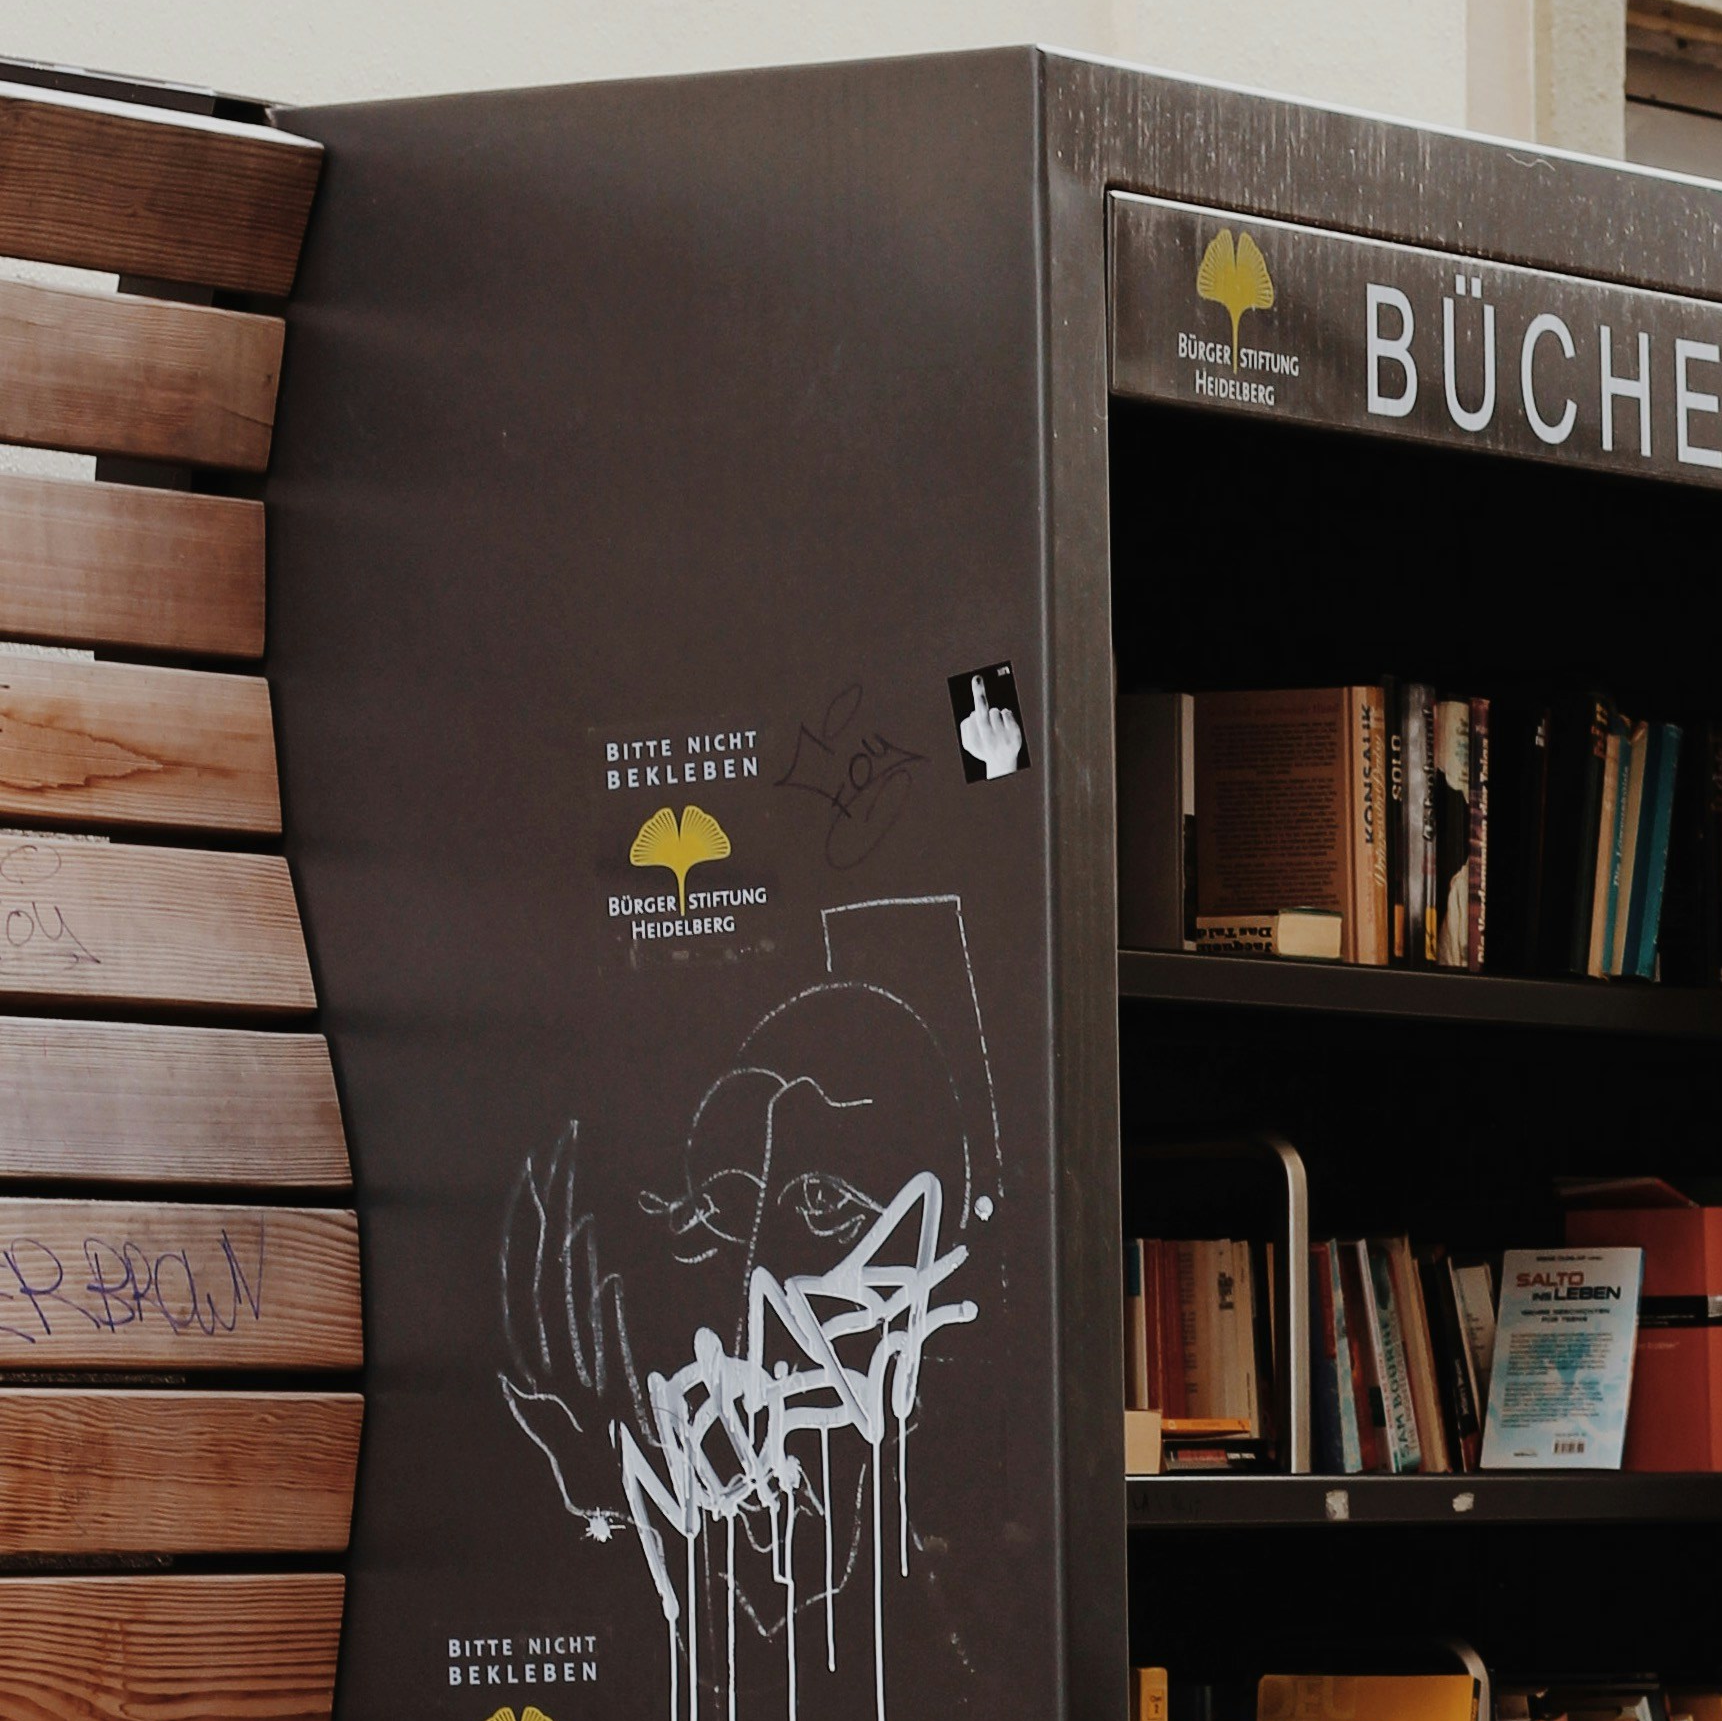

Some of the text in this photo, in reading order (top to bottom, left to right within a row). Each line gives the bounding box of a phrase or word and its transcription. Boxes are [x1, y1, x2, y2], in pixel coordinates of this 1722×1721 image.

[1177, 333, 1300, 378] BÜRGER STIFTUNG
[1194, 369, 1276, 408] HEIDELBERG
[606, 731, 757, 762] BITTE NICHT
[606, 758, 760, 790] BEKLEBEN
[1361, 704, 1375, 845] KONSALIK
[1391, 734, 1403, 802] SOLO
[608, 886, 768, 917] BÜRGER STIFTUNG
[632, 915, 735, 940] HEIDELBERG
[1516, 1272, 1584, 1288] SALTO
[1553, 1286, 1621, 1300] LEBEN
[1396, 1414, 1410, 1459] SAM
[448, 1635, 596, 1658] BITTE NICHT
[449, 1662, 598, 1686] BEKLEBEN
